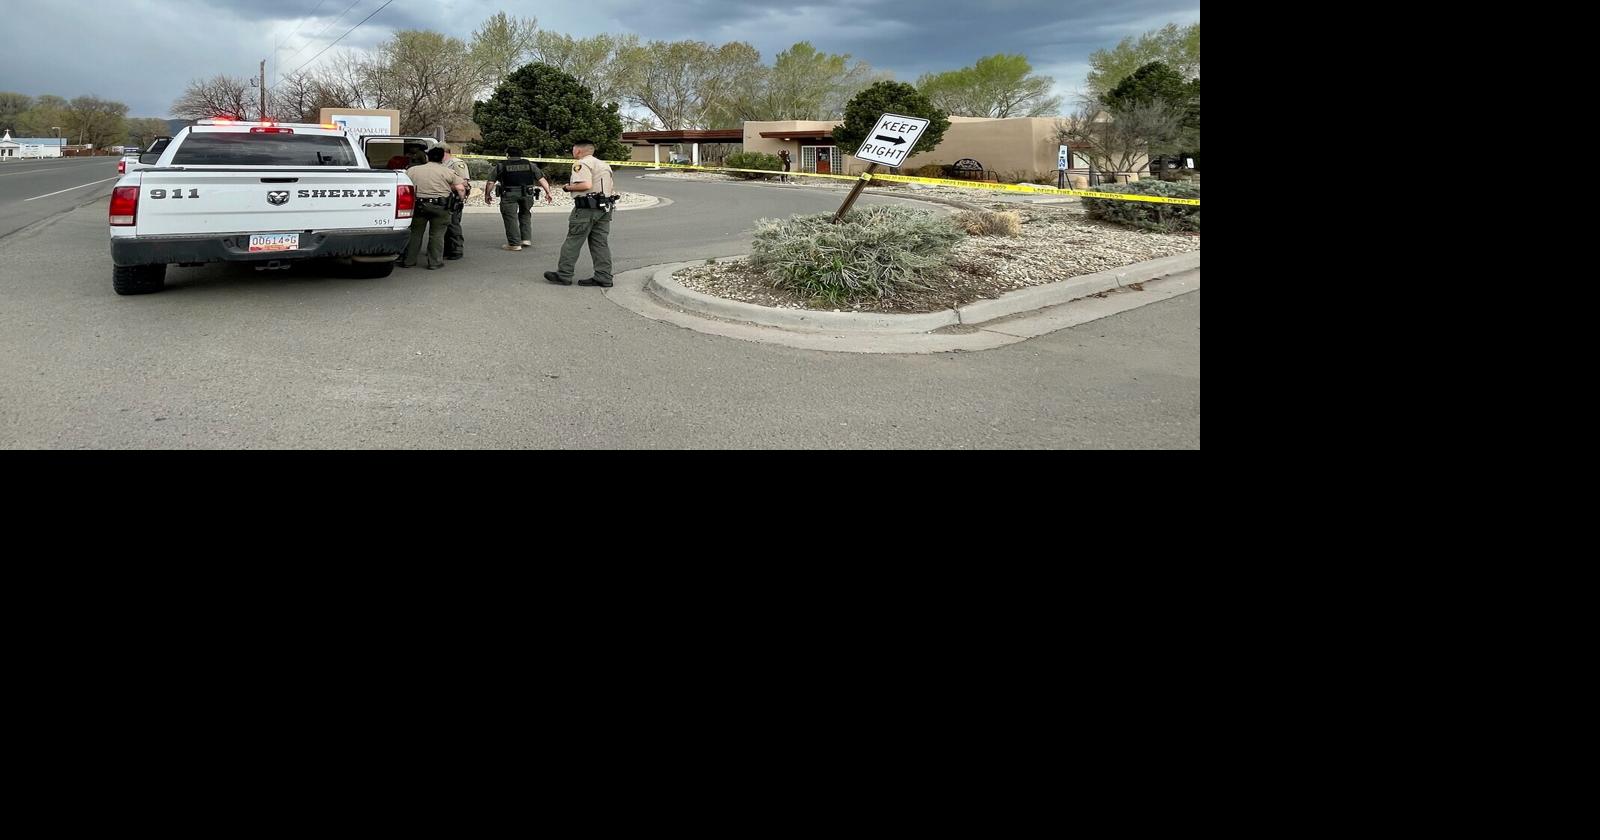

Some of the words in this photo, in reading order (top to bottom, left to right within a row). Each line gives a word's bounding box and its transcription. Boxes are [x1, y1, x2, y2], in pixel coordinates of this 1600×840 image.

[880, 120, 918, 134] KEEP
[862, 143, 905, 159] RIGHT
[150, 188, 200, 199] 911
[297, 189, 391, 198] SHERIFF
